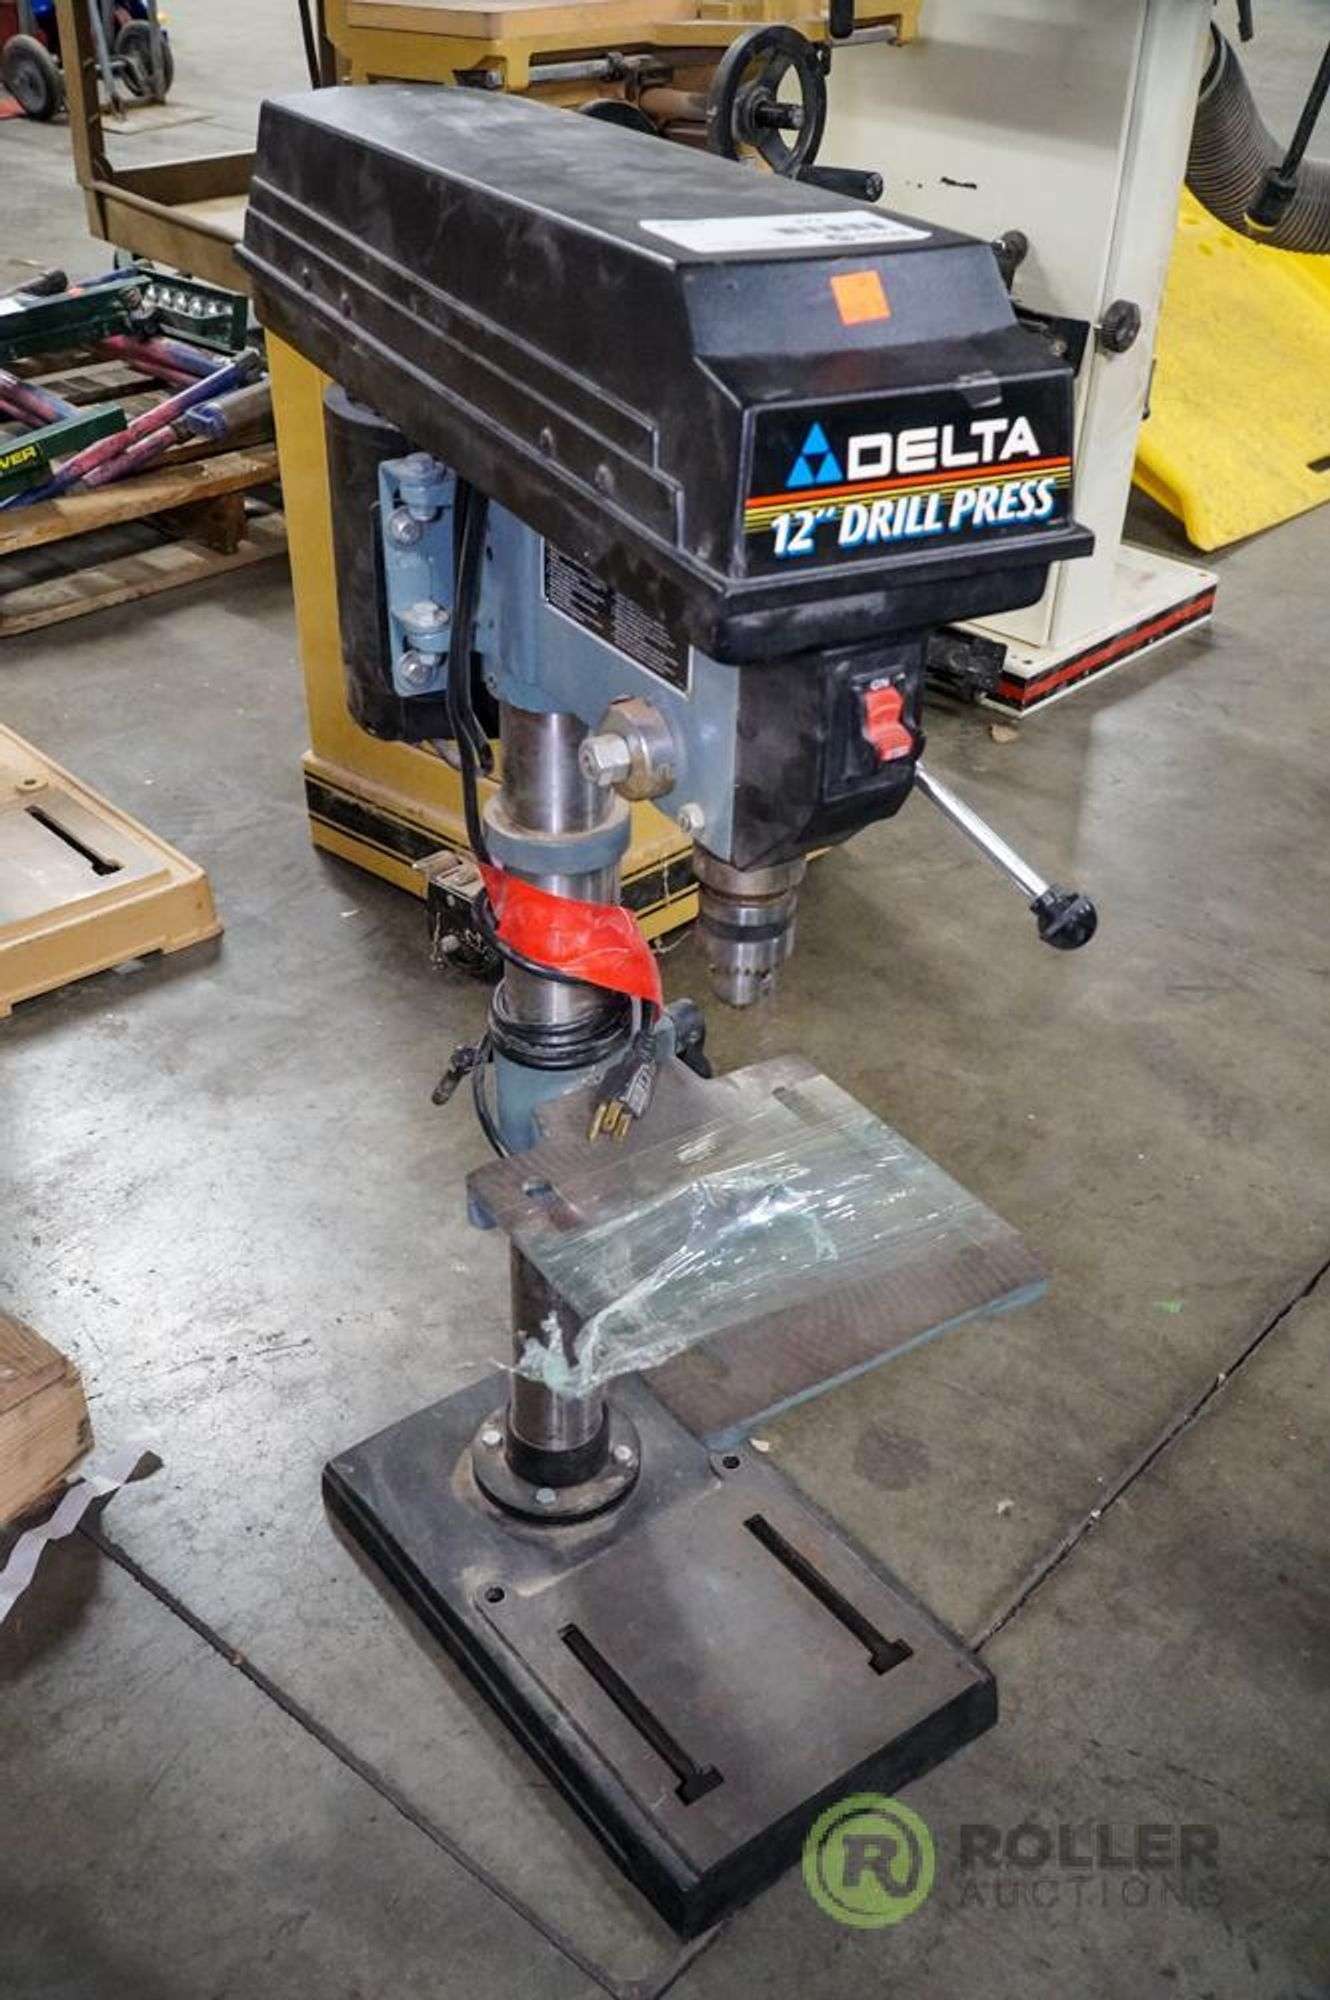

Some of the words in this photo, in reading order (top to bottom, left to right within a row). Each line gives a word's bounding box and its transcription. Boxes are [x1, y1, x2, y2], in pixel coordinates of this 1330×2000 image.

[847, 416, 1041, 480] DELTA
[838, 492, 945, 548] DRILL
[948, 478, 1057, 532] PRESS
